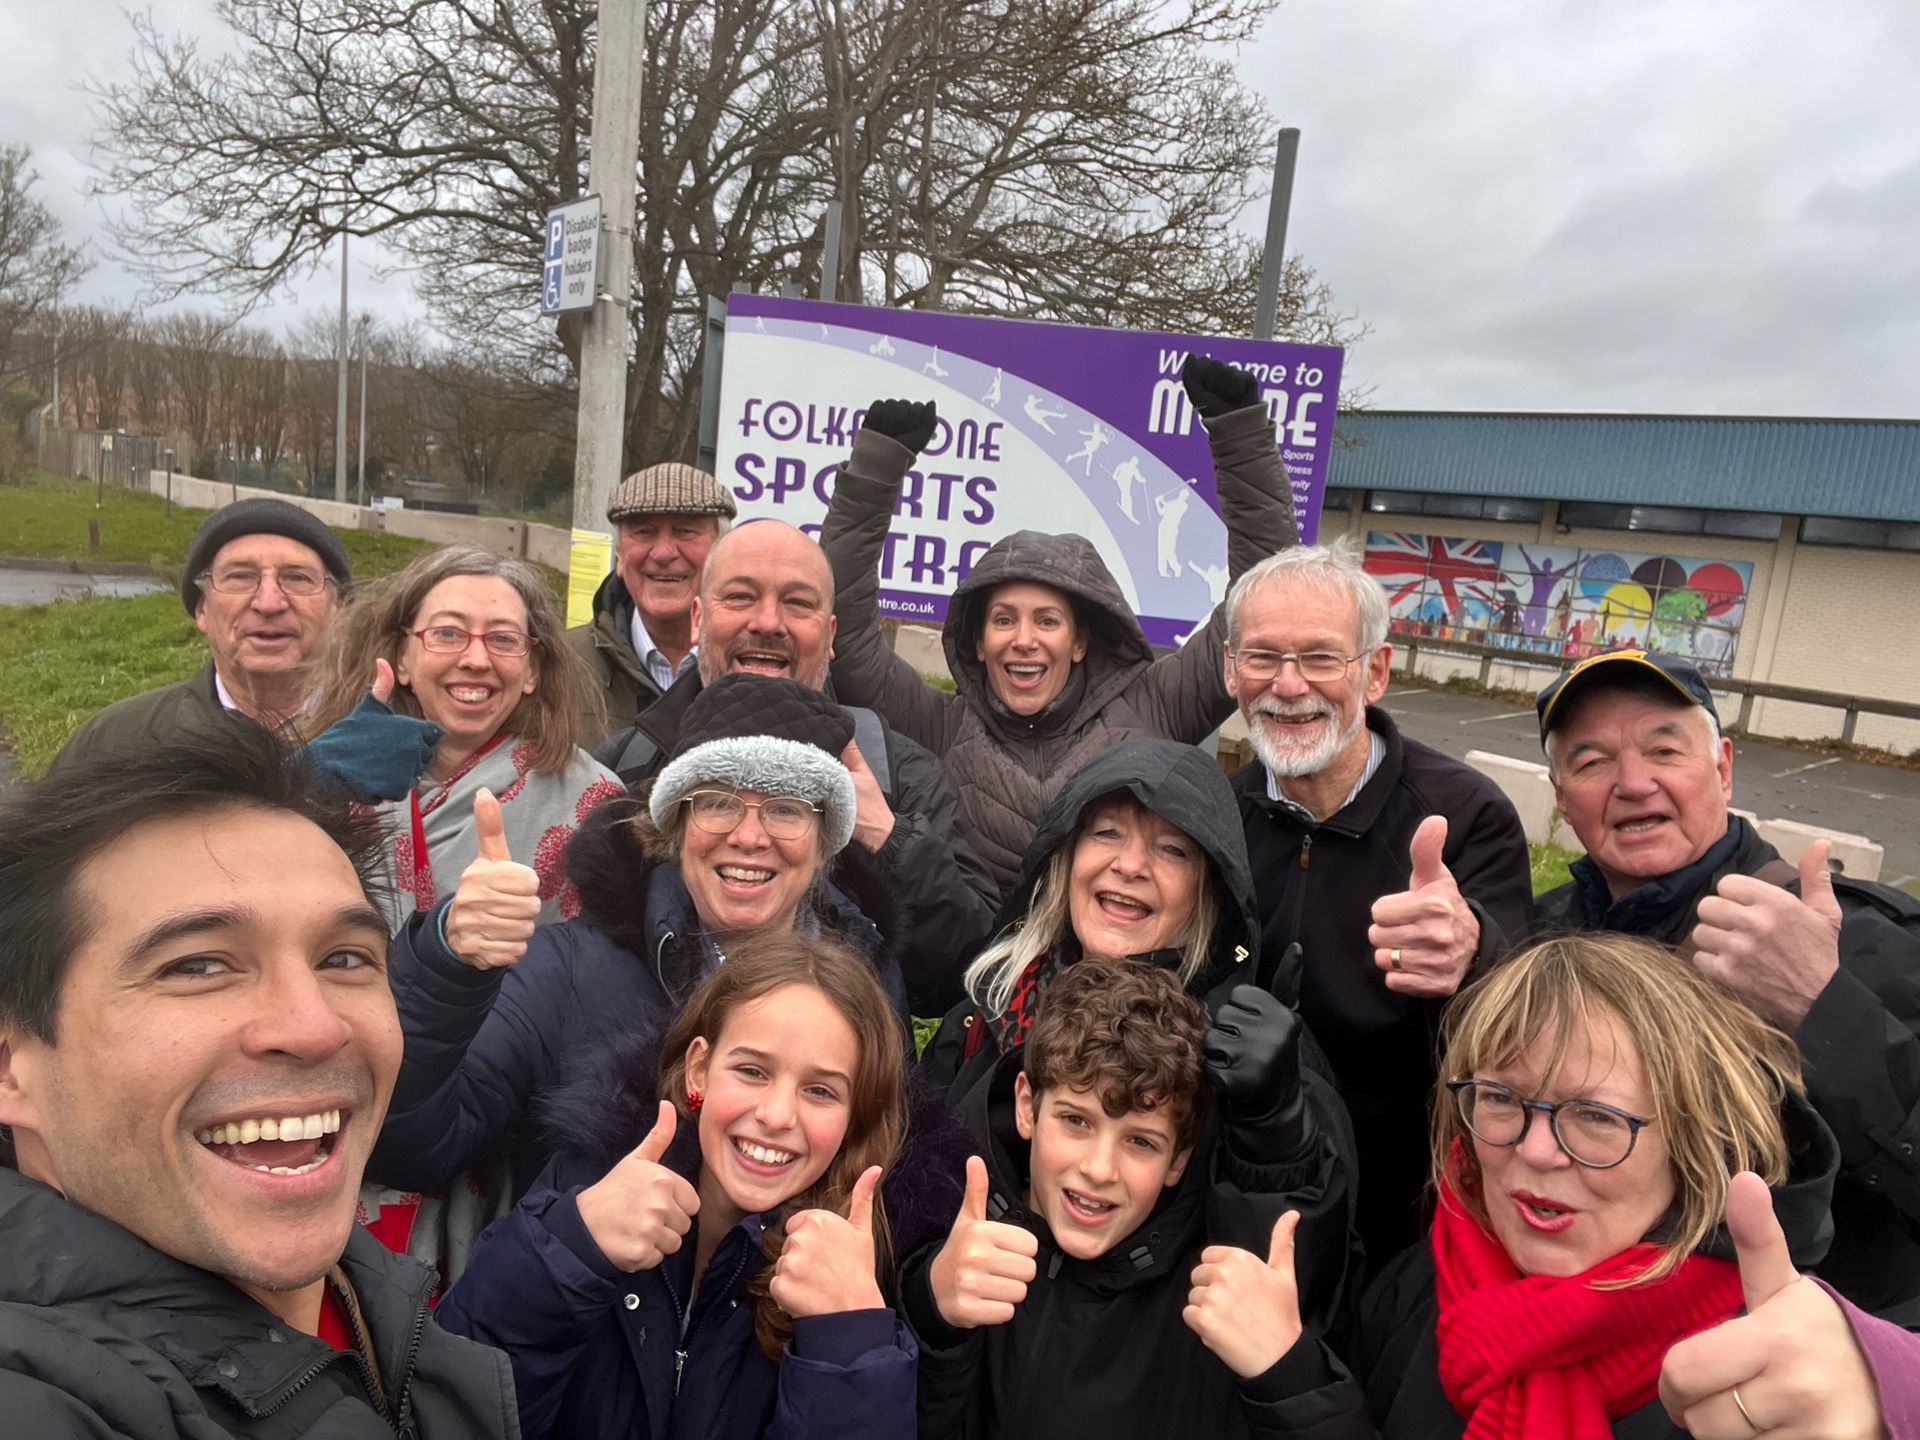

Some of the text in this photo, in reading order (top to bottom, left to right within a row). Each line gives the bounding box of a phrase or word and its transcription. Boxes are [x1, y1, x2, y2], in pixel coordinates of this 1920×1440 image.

[566, 213, 598, 235] Disabled
[550, 220, 562, 257] P
[568, 237, 592, 254] badge
[564, 260, 593, 276] holders
[568, 278, 586, 296] only
[1294, 362, 1323, 387] to
[1148, 378, 1324, 447] MRE
[1283, 449, 1315, 461] Sports
